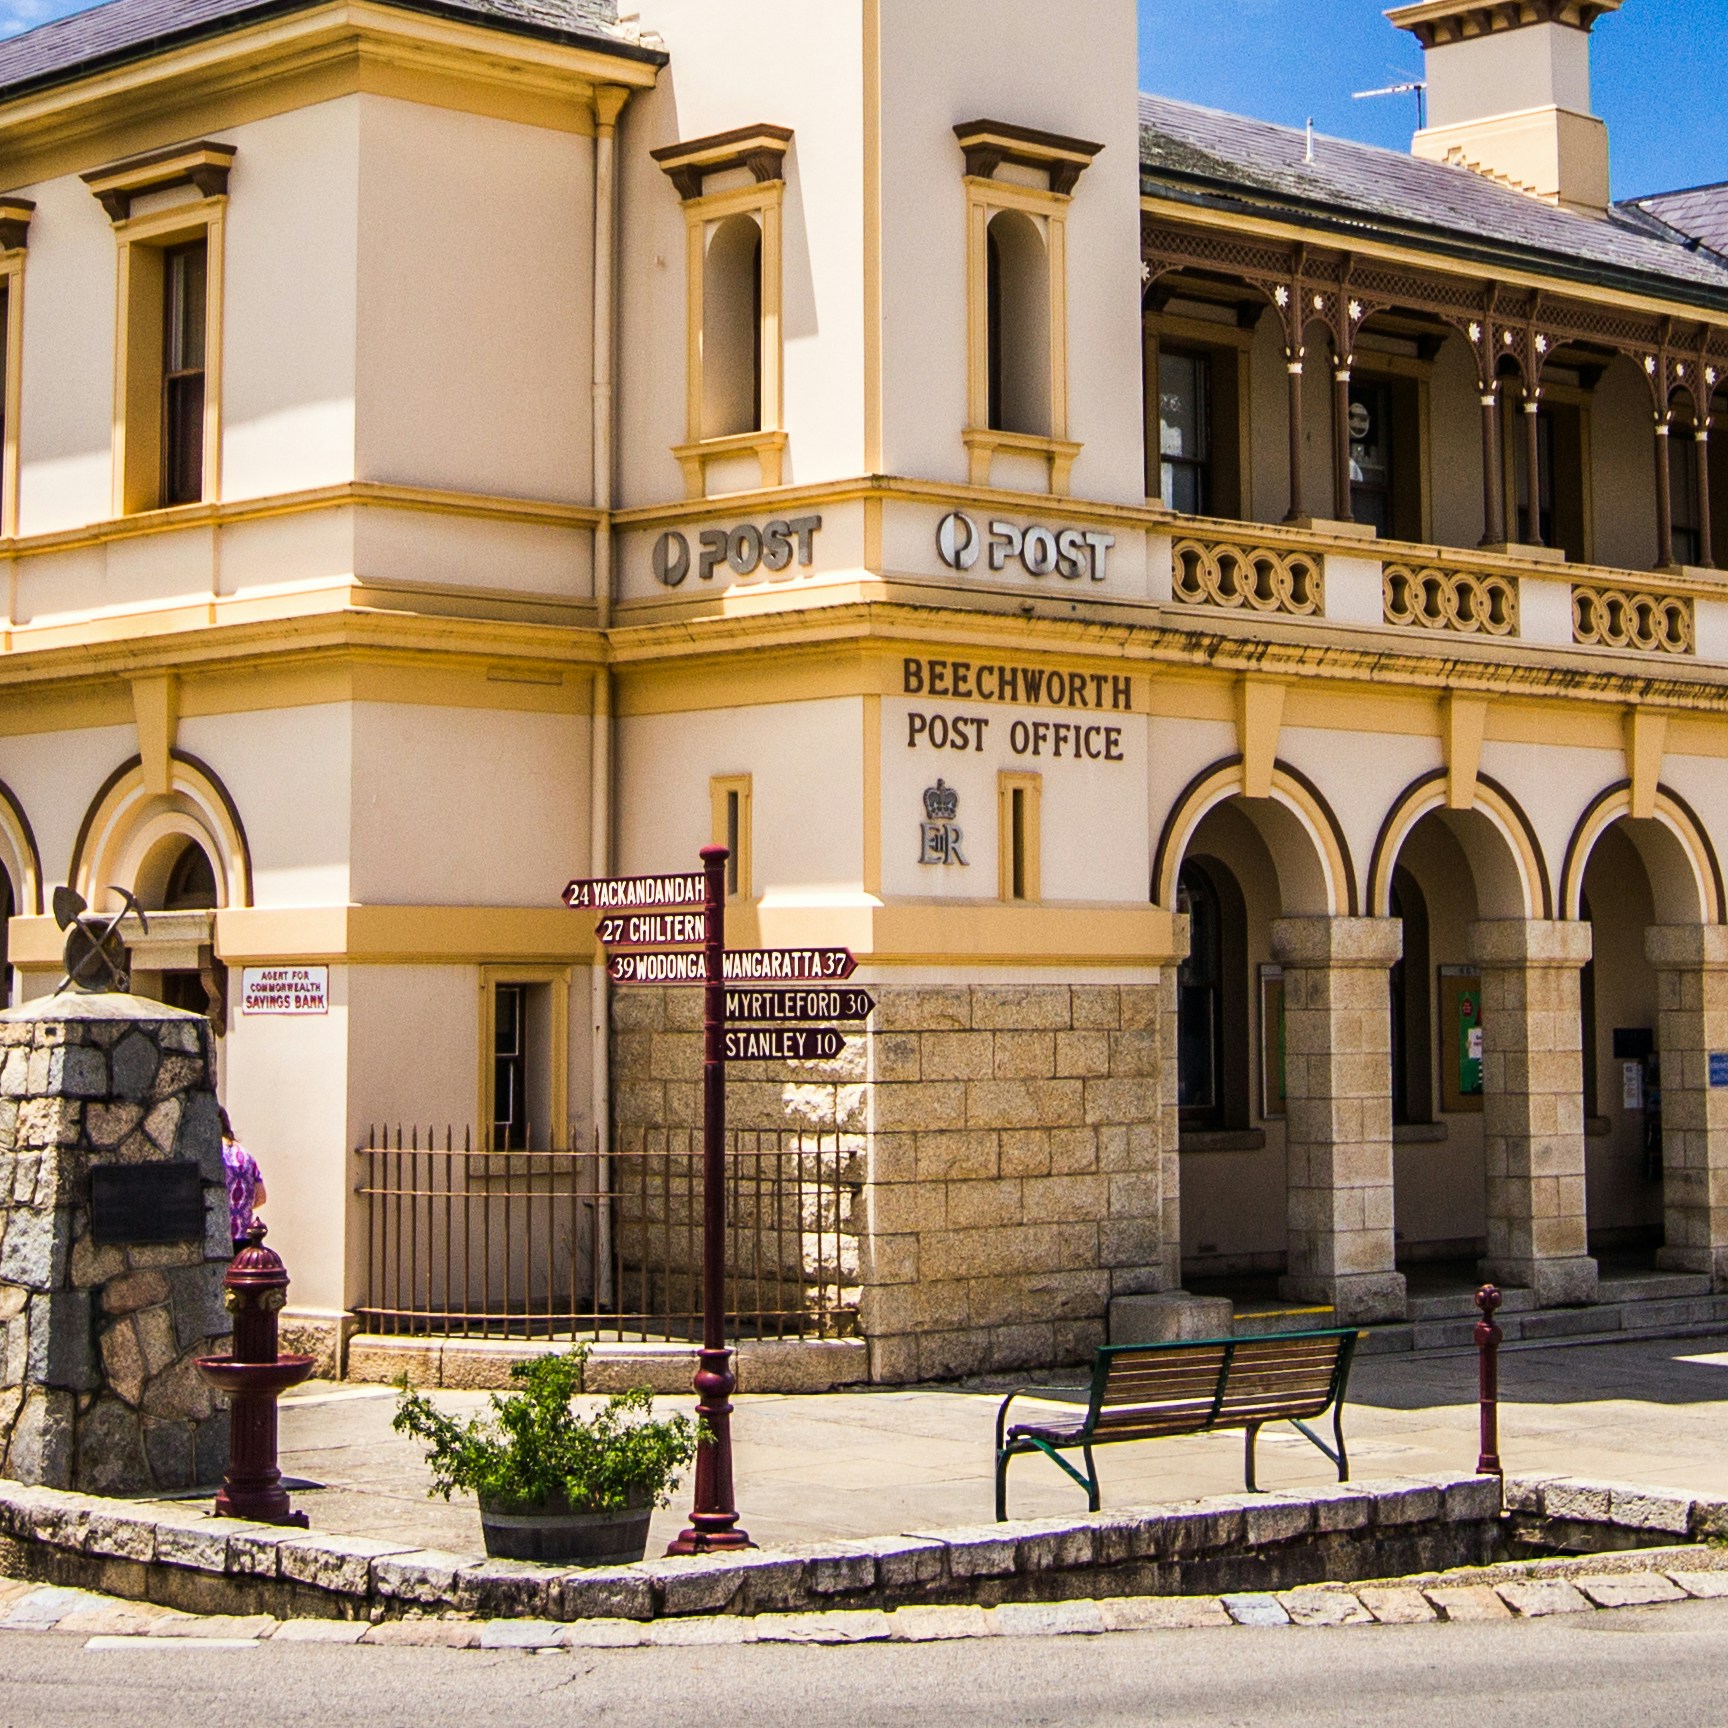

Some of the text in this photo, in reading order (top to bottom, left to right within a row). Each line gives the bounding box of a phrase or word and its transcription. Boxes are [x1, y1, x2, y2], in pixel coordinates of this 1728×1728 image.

[699, 514, 822, 580] POST
[989, 521, 1116, 582] POST
[903, 658, 1133, 710] BEECHWORTH
[907, 712, 1124, 761] POST OFFICE
[569, 876, 705, 907] 24 YACKANDANDAH
[602, 914, 705, 942] 27 CHILTERN
[261, 970, 310, 981] AGENT FOR
[613, 953, 707, 980] 39 WODONGA
[722, 952, 846, 978] WANGARATTA 37
[250, 982, 321, 993] COMMONWEALTH
[246, 994, 325, 1009] SAVINGS BANK
[726, 992, 869, 1018] MYRTLEFORD 30
[725, 1032, 837, 1058] STANLEY 10
